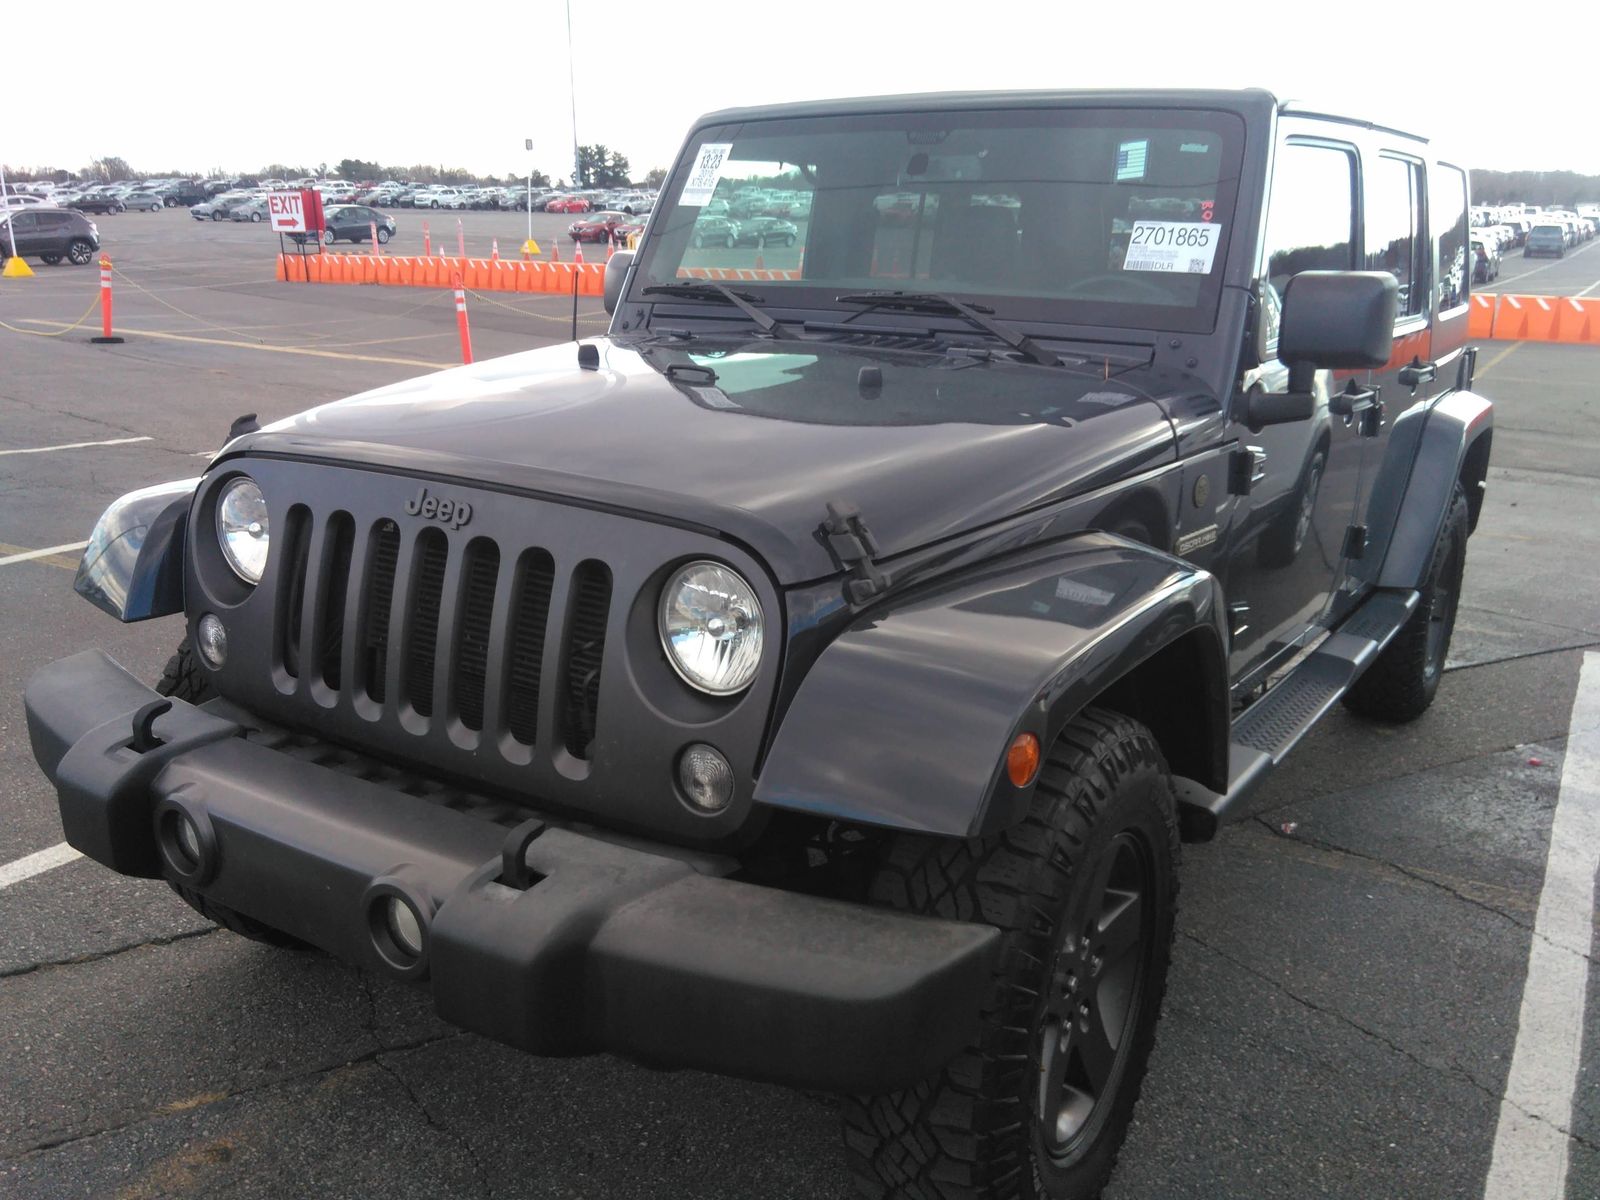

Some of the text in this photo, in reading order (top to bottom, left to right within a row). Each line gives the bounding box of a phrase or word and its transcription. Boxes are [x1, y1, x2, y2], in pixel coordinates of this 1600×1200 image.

[269, 196, 300, 214] EXIT
[1132, 226, 1210, 247] 2701865
[1154, 262, 1174, 270] DLR
[404, 487, 473, 530] Jeep
